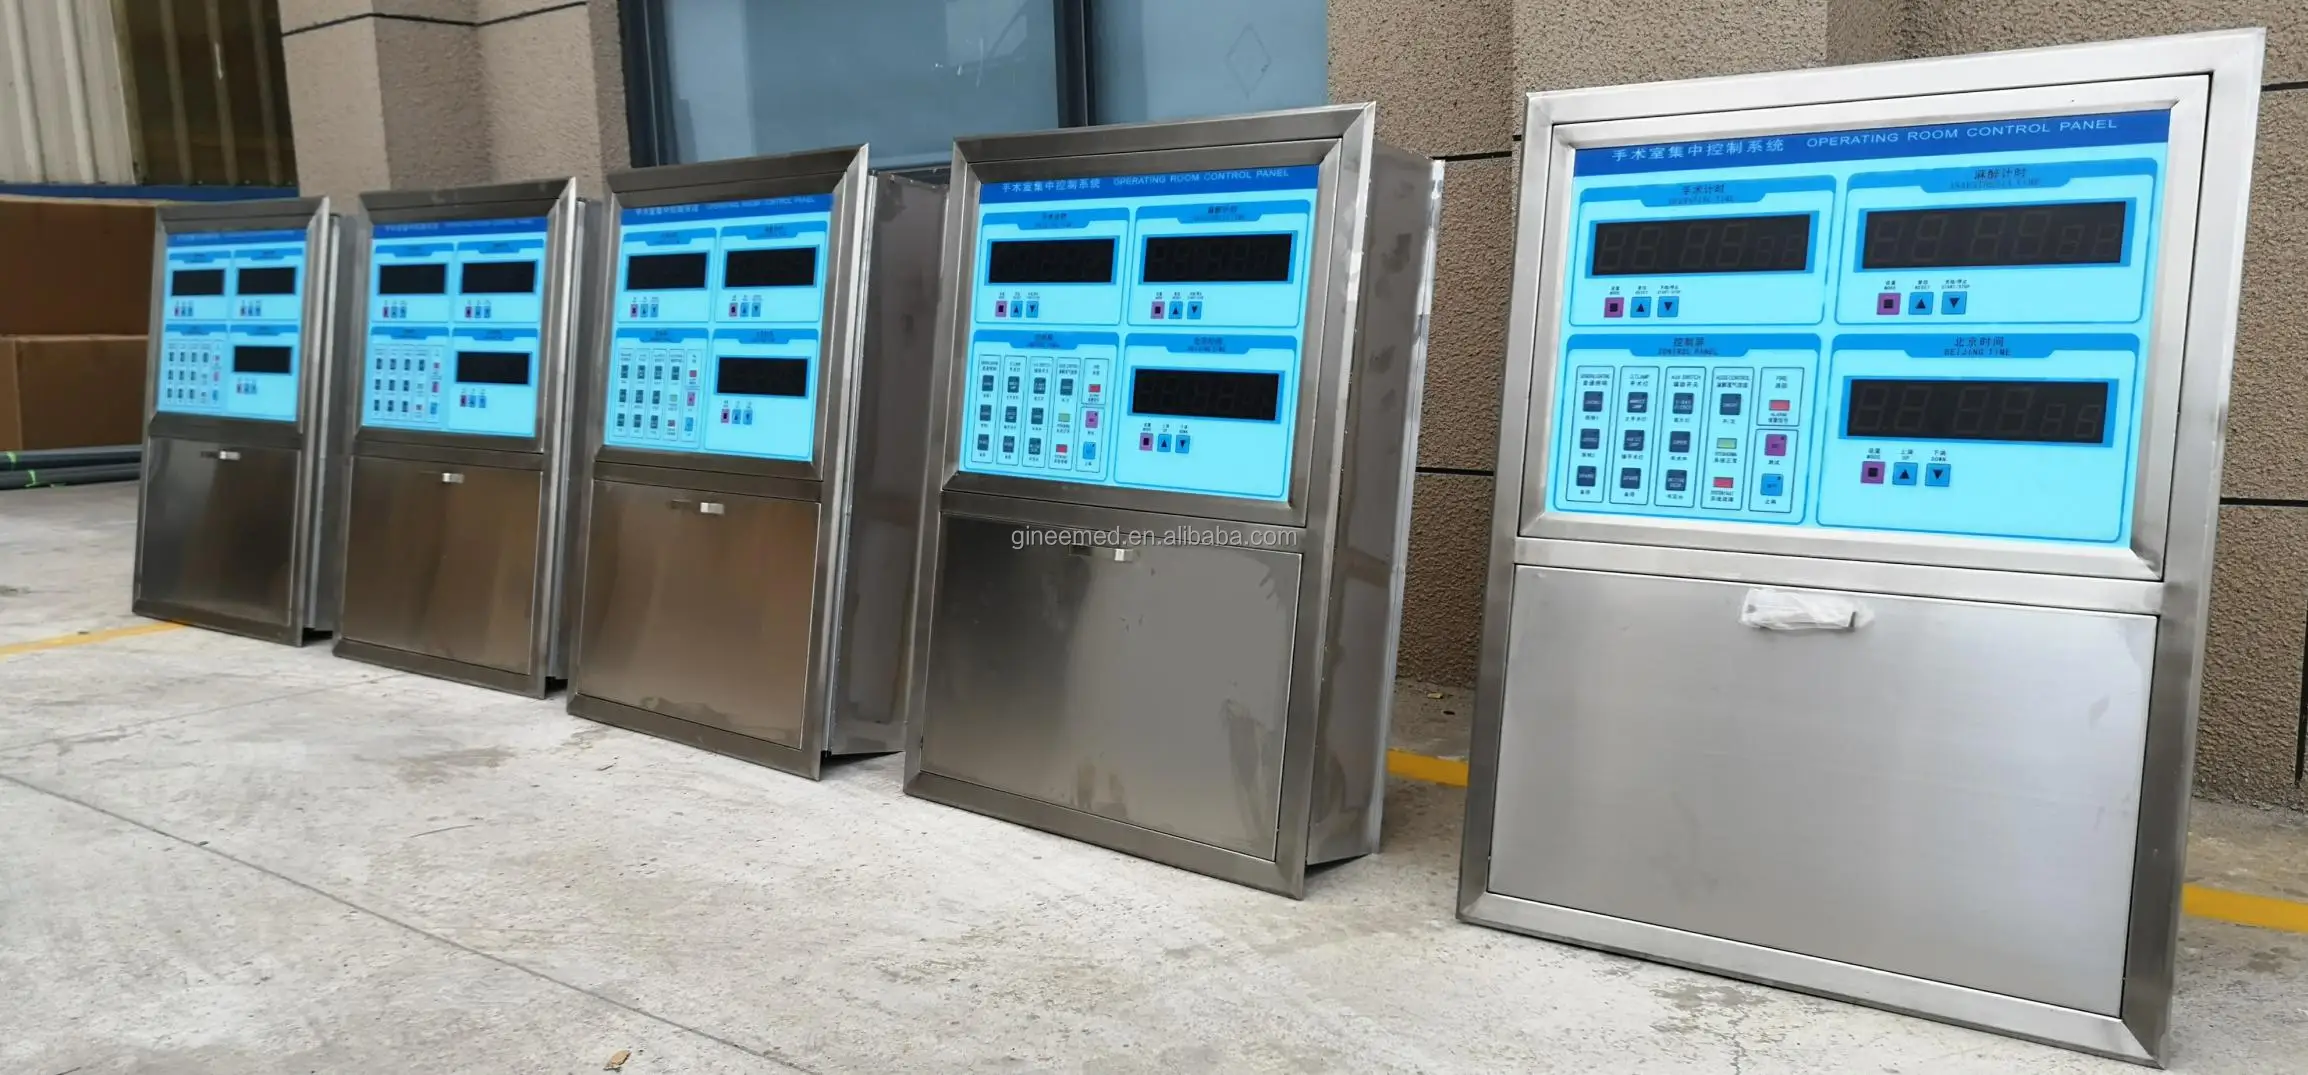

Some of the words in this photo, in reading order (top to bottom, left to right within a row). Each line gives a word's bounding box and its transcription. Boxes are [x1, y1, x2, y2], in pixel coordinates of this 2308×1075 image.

[1806, 132, 1899, 148] OPERATING
[1907, 128, 1959, 141] ROOM
[1966, 123, 2051, 138] CONTROL
[2059, 118, 2117, 132] PANEL
[1611, 138, 1785, 162] 手术室集中控制系统
[1113, 175, 1166, 186] OPERATING
[1170, 173, 1200, 183] ROOM
[1203, 170, 1252, 181] CONTROL
[1256, 167, 1289, 178] PANEL
[1954, 336, 2004, 348] 北京时间
